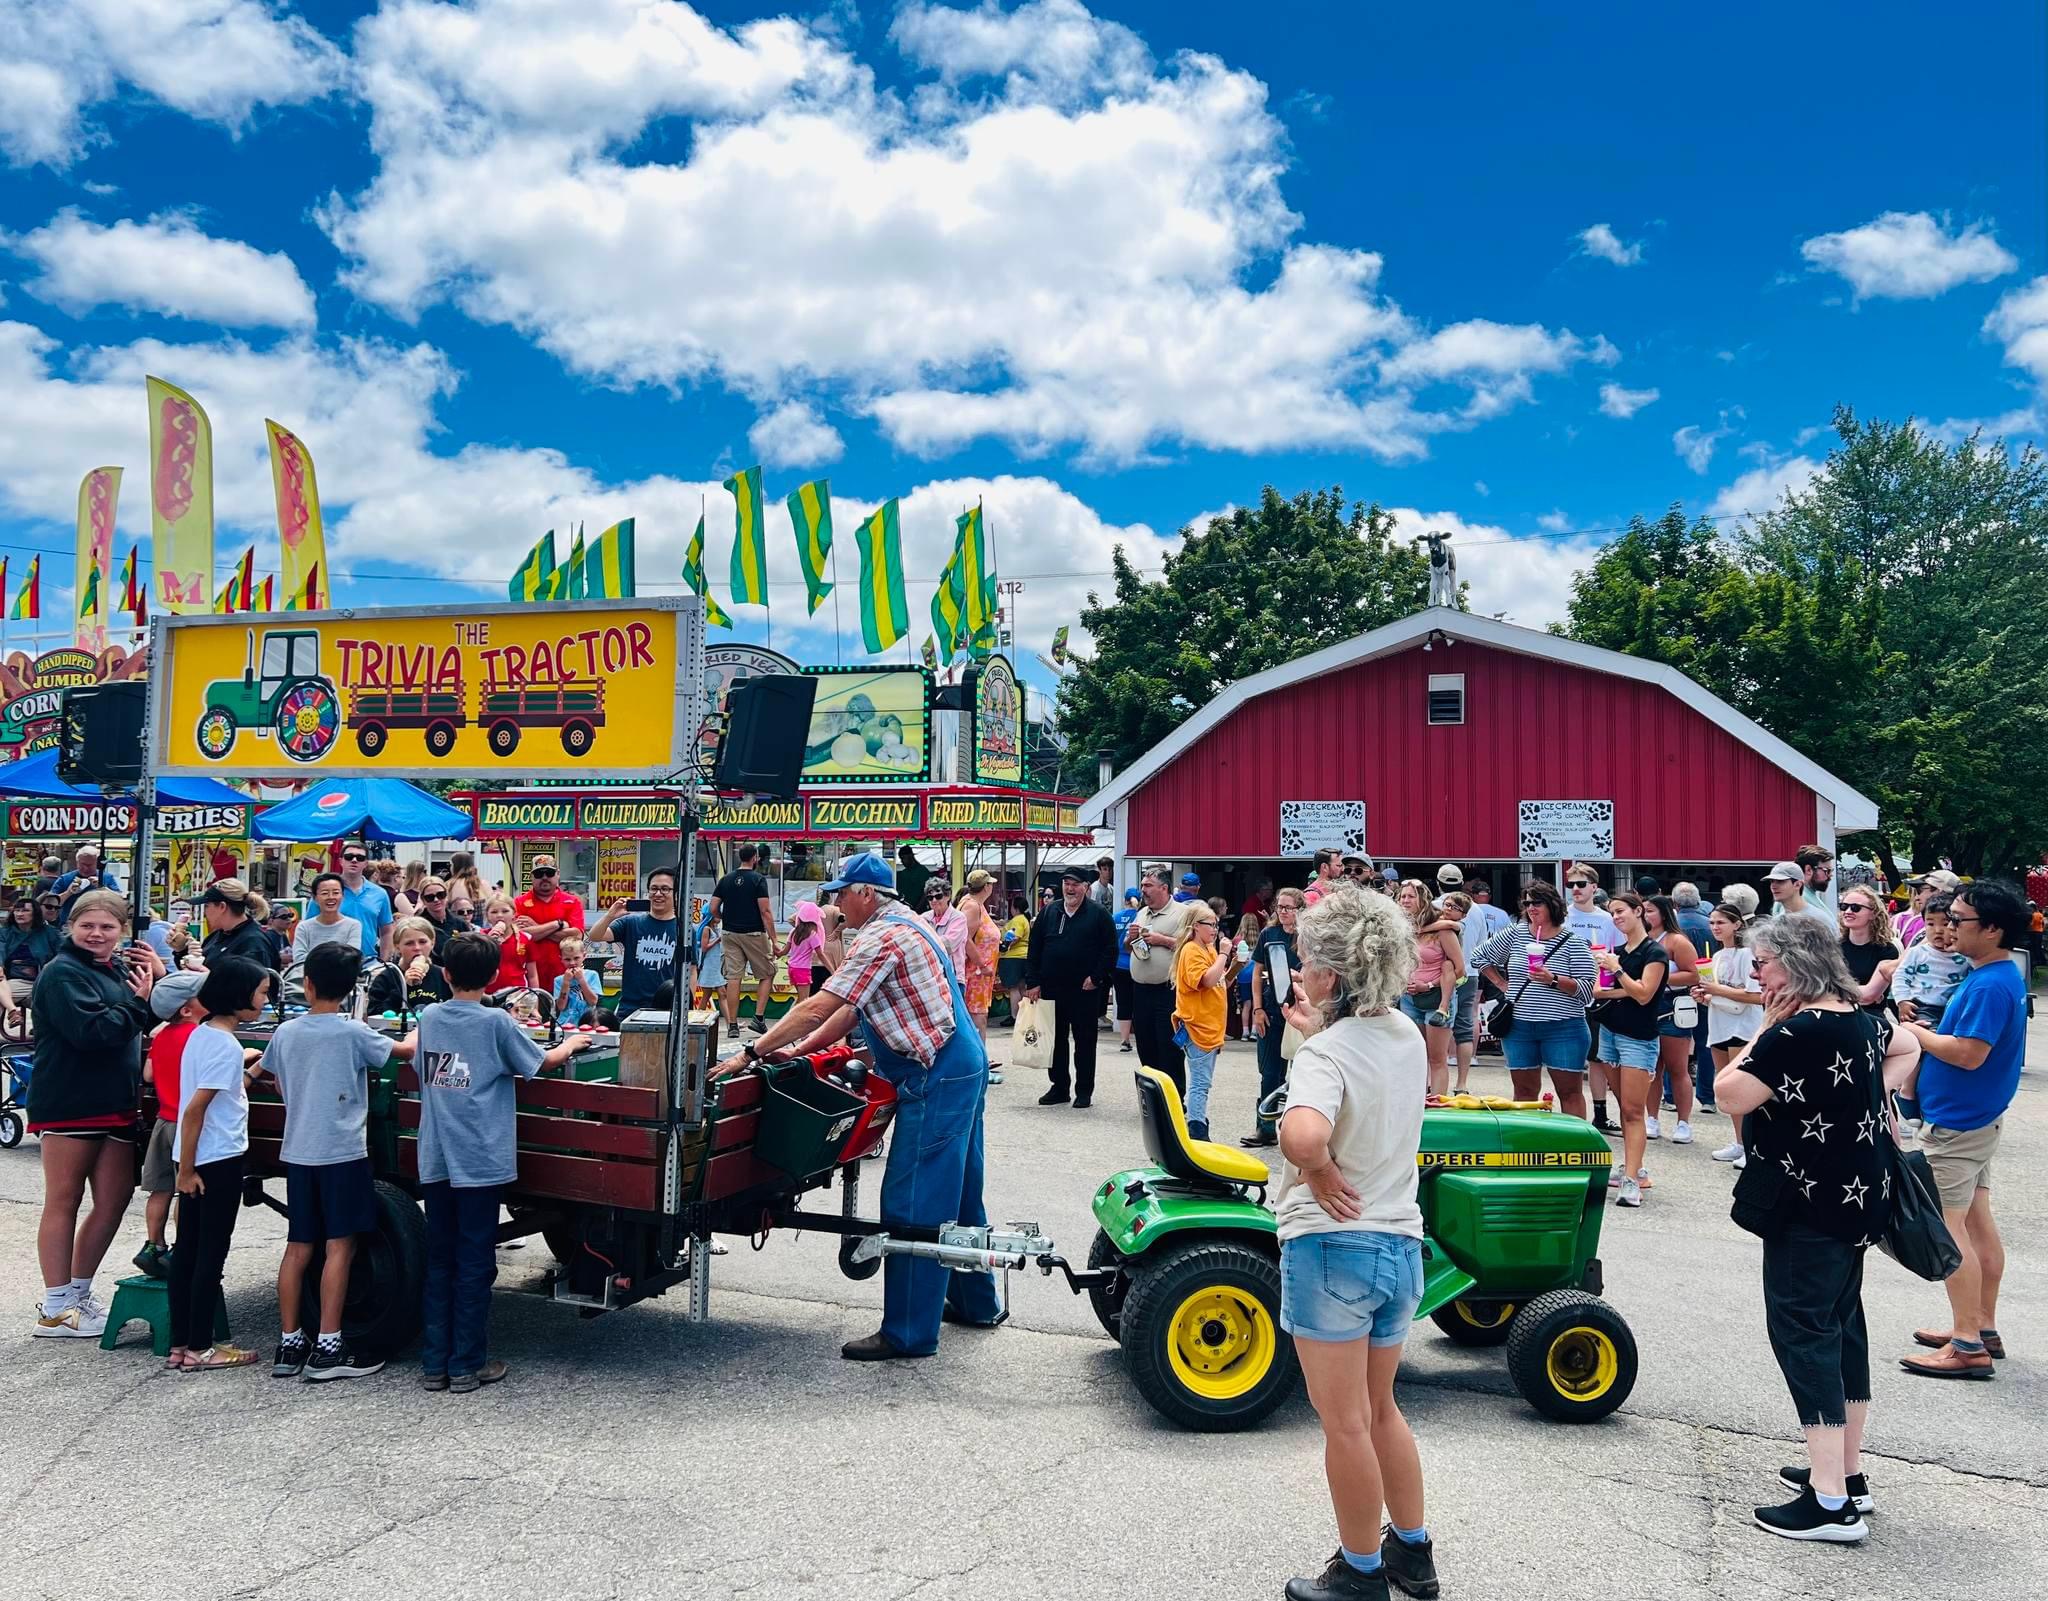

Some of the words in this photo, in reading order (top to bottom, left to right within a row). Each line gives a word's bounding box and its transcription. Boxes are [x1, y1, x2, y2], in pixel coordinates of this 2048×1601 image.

[455, 622, 489, 646] THE
[37, 654, 61, 673] HAND
[62, 654, 94, 670] DIPPED
[337, 639, 463, 693] TRIVIA
[480, 622, 655, 693] TRACTOR
[705, 653, 741, 664] RIED
[33, 673, 97, 689] JUMBO
[10, 692, 61, 721] CORN
[156, 807, 240, 832] FRIES
[484, 803, 571, 824] BROCCOLI
[584, 803, 676, 825] CAULIFLOWER
[704, 803, 801, 824] MUSHROOMS
[815, 801, 916, 824] ZUCCHINI
[932, 800, 974, 824] FRIED
[978, 800, 1020, 824] PICKLES
[602, 861, 635, 875] SUPER
[600, 878, 637, 892] VEGGIE
[643, 946, 668, 955] NAACL
[1423, 1153, 1486, 1166] DEERE
[1544, 1152, 1582, 1166] 216
